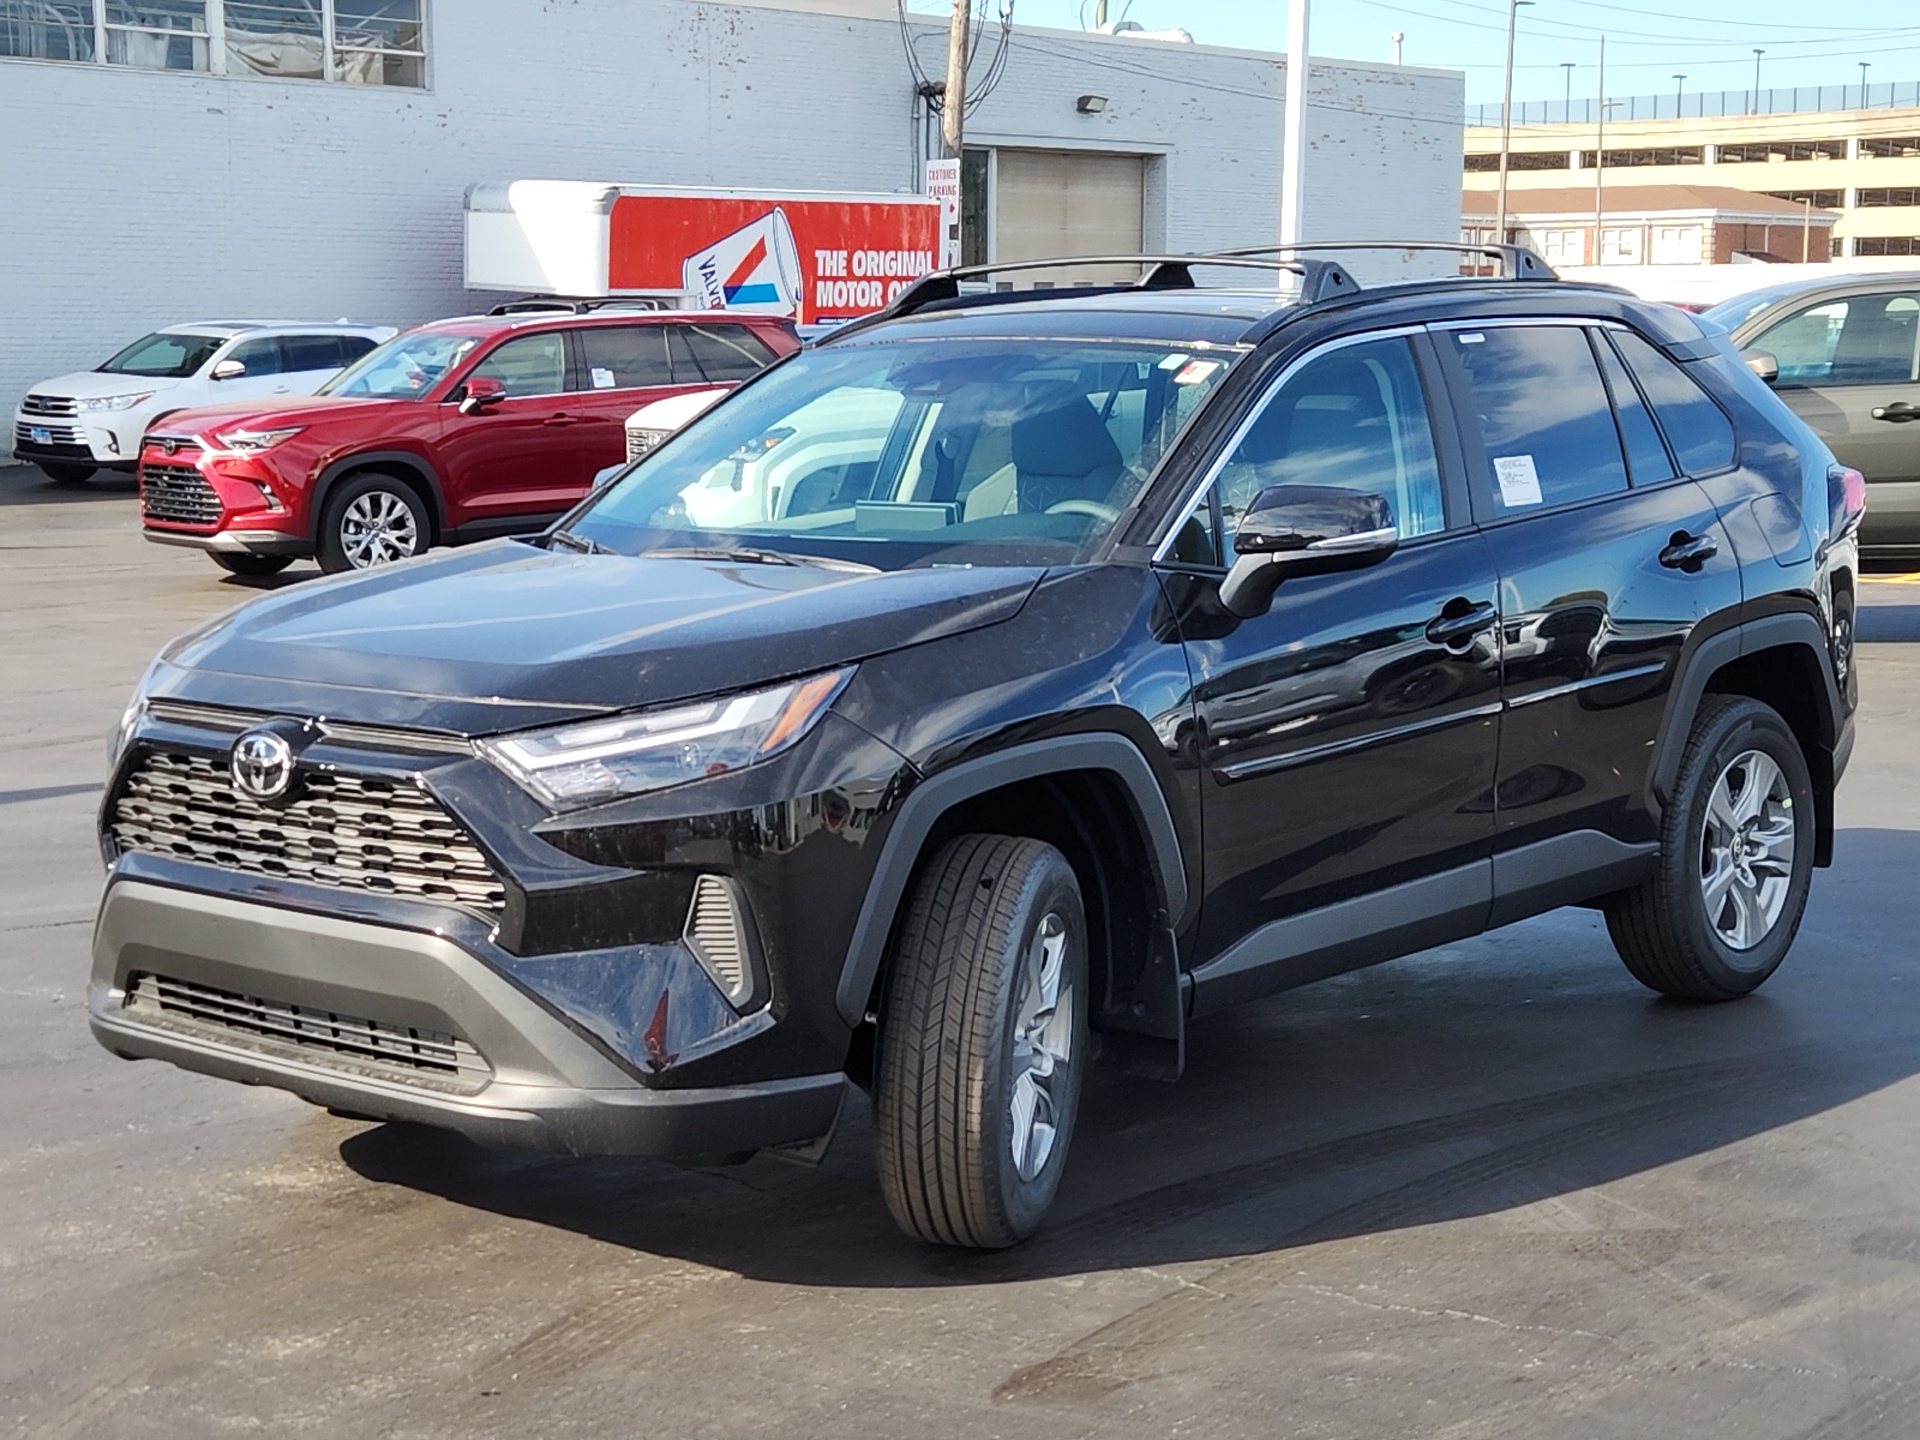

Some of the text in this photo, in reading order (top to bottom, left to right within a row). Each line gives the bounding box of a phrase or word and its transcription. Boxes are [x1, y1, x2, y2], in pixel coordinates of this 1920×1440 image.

[928, 168, 957, 181] CUSTOMER
[928, 184, 957, 196] PARKING
[815, 249, 937, 277] THE ORIGINAL
[816, 280, 883, 308] MOTOR
